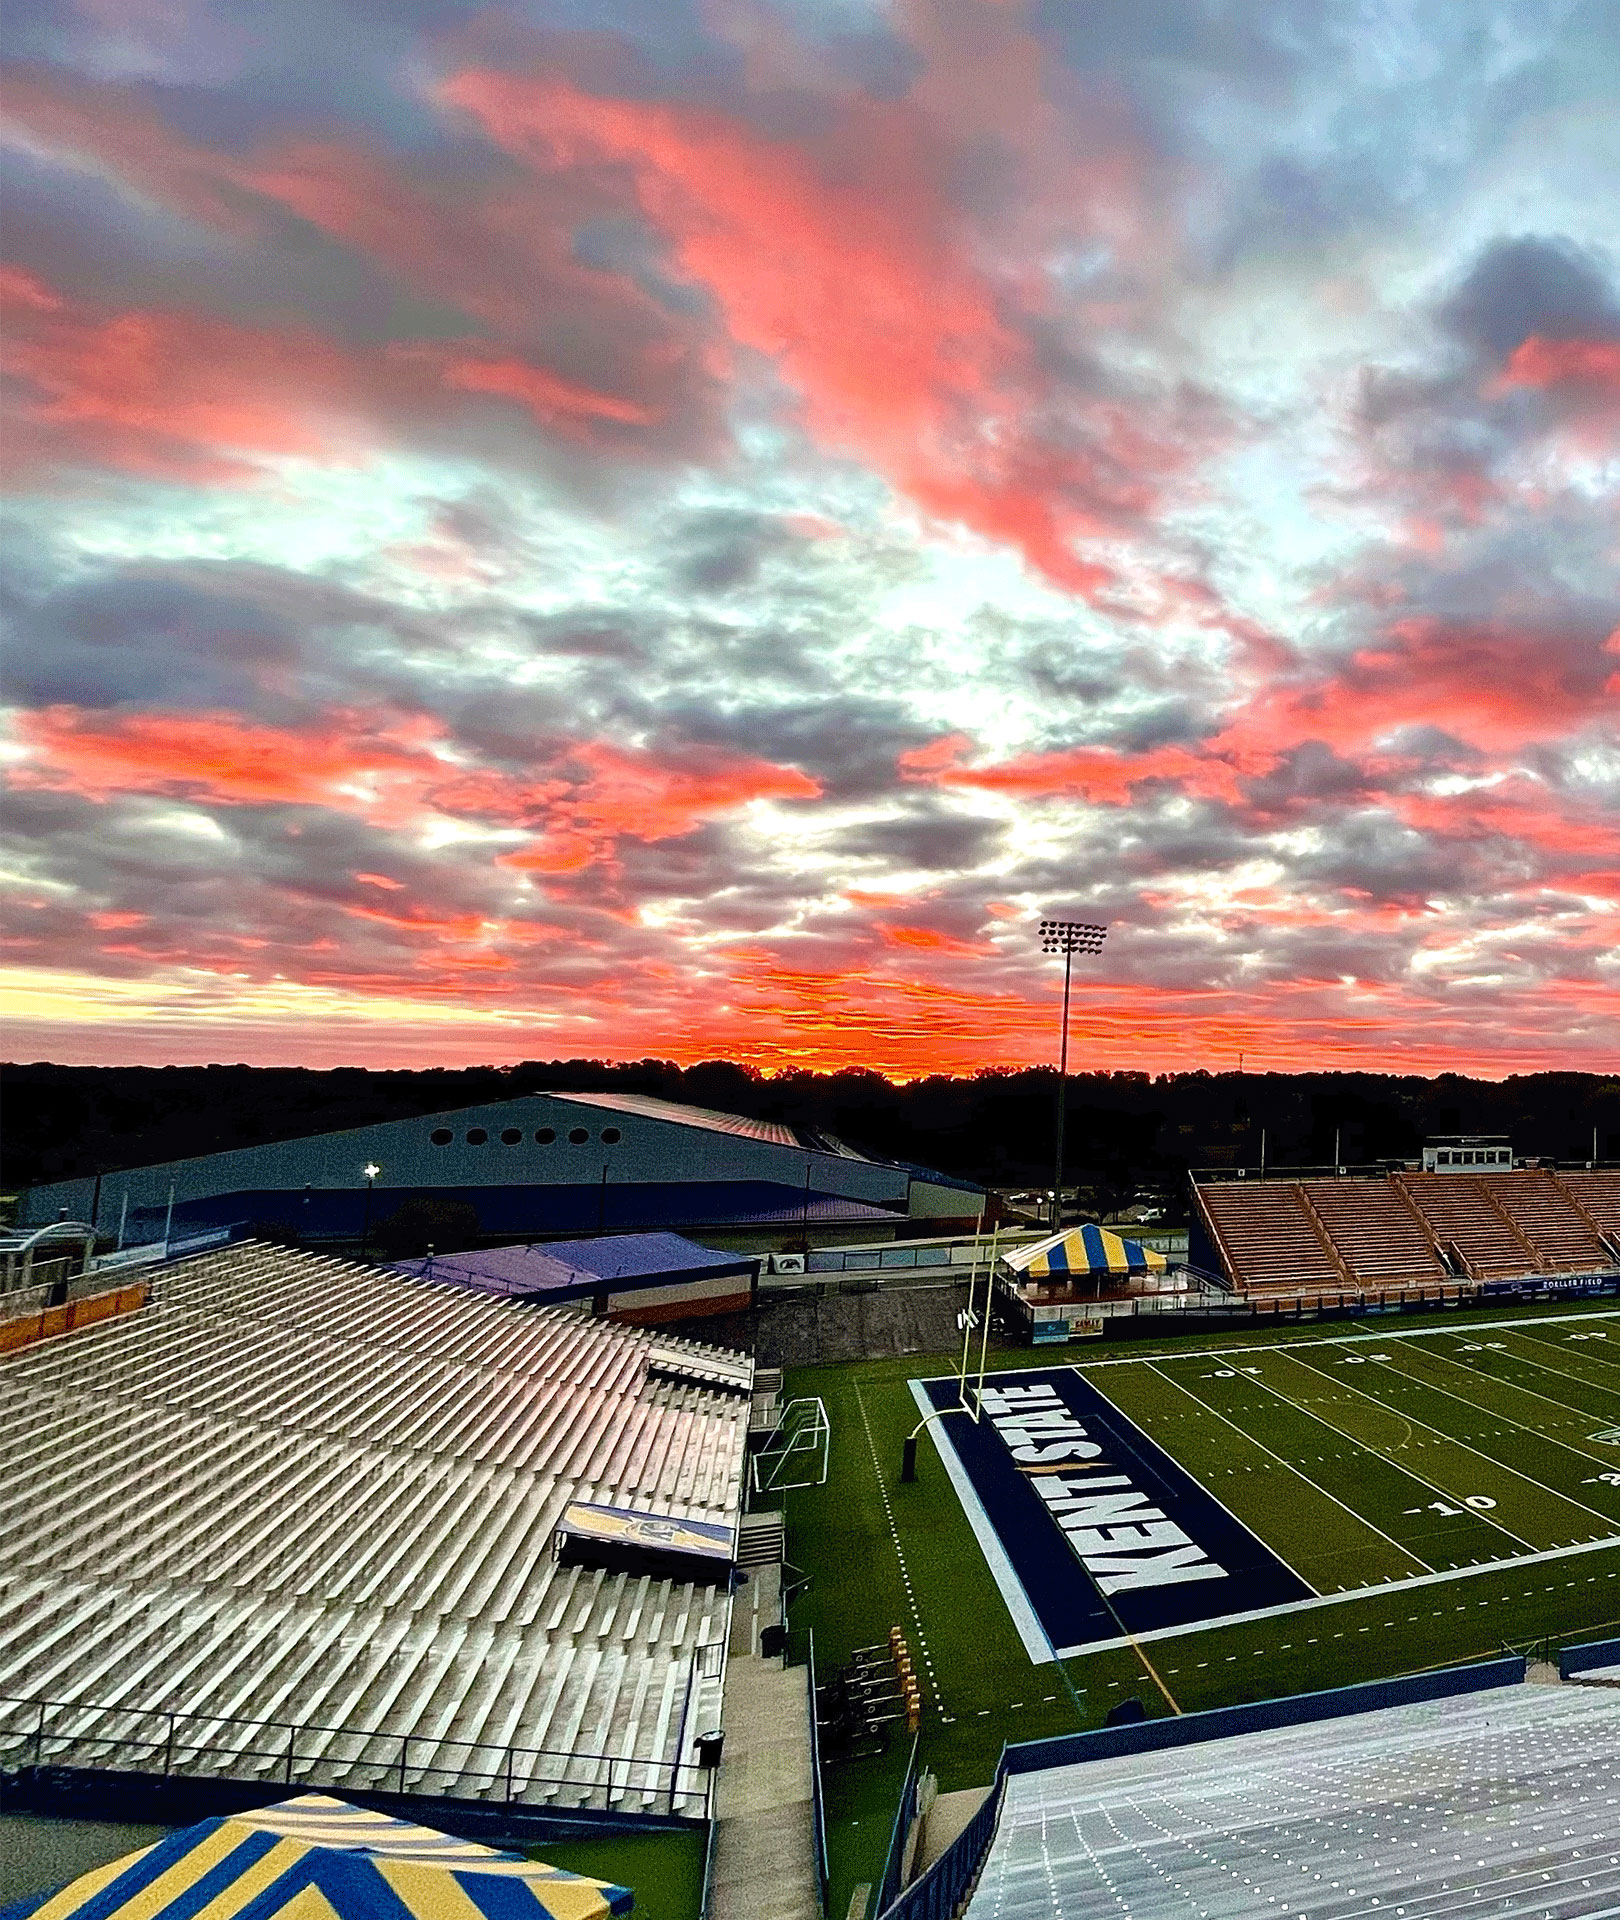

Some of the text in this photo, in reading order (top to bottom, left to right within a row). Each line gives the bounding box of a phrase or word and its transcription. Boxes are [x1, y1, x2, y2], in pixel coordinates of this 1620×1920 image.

[1214, 1366, 1263, 1378] 10
[972, 1384, 1230, 1597] KENT STATE
[1428, 1495, 1497, 1517] 10
